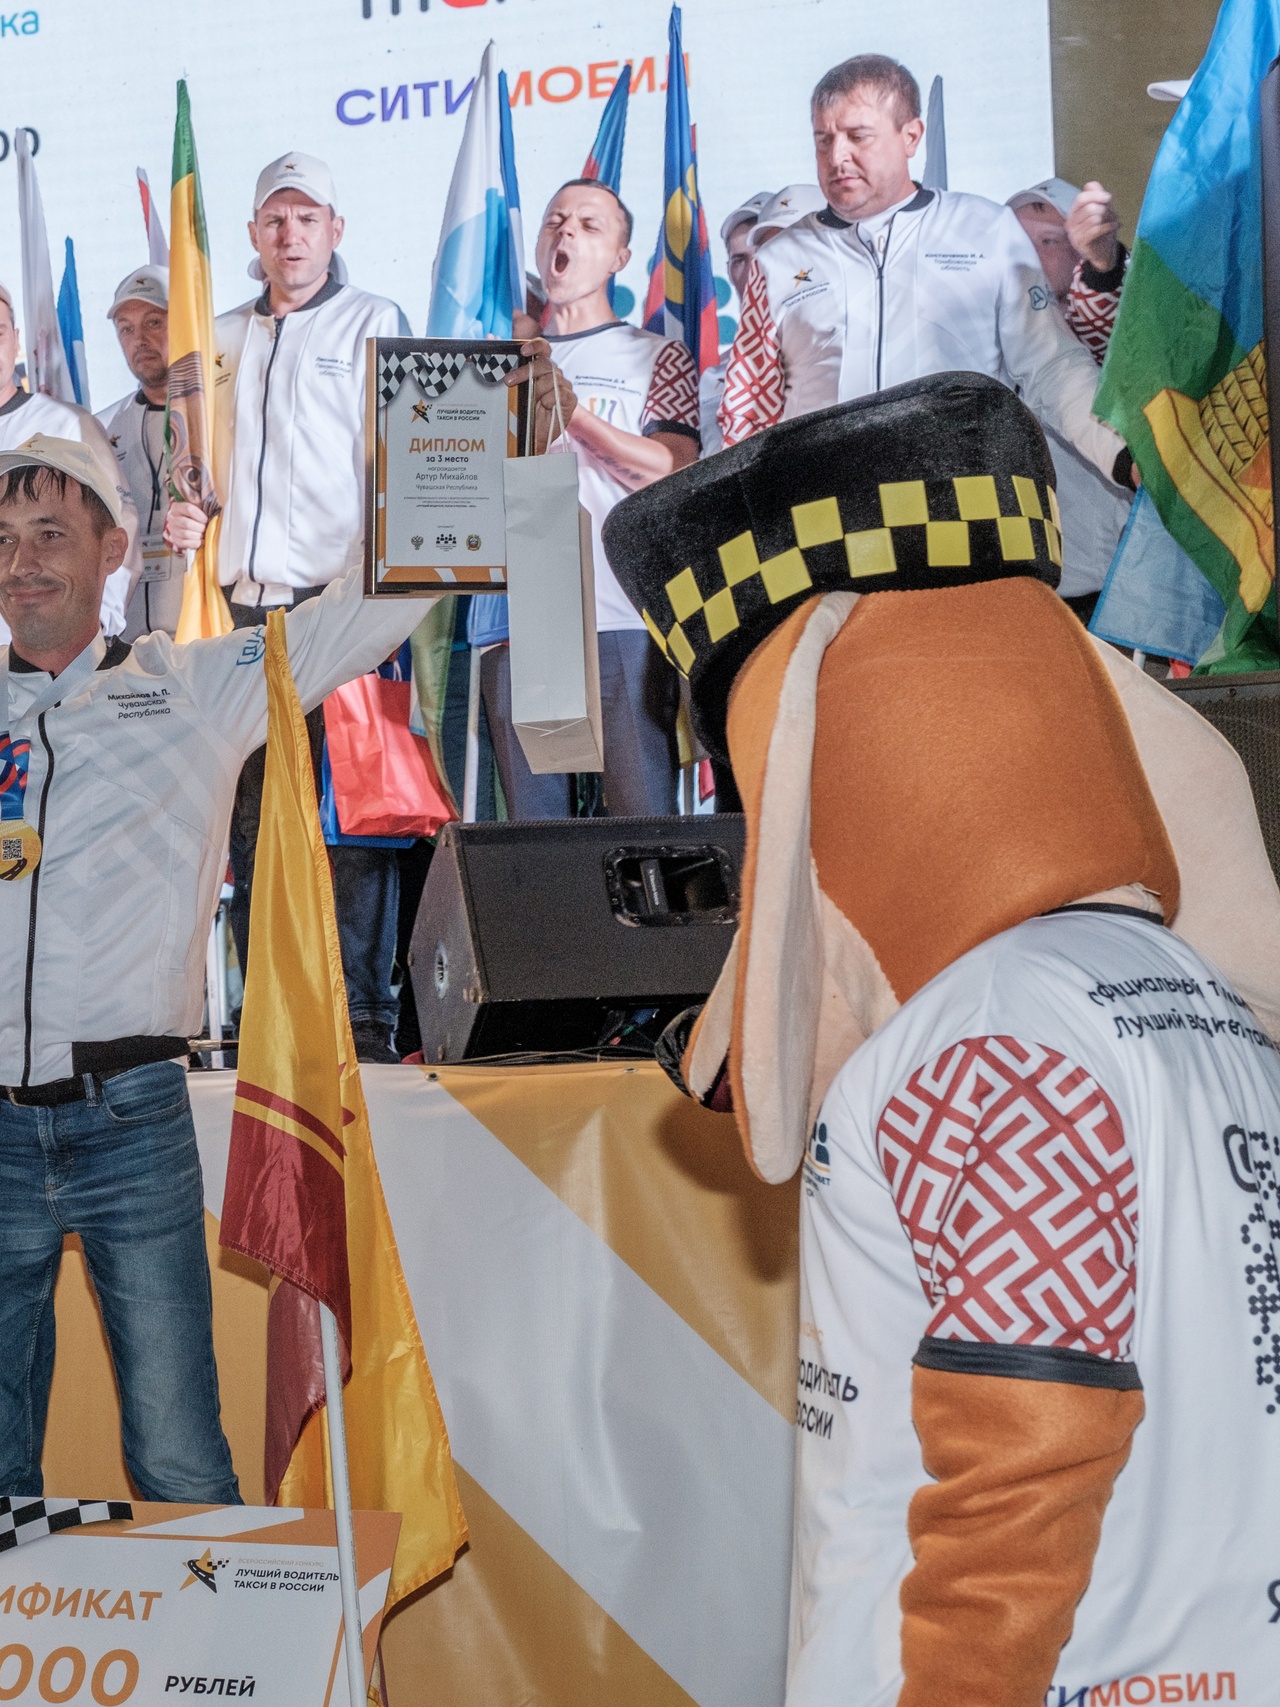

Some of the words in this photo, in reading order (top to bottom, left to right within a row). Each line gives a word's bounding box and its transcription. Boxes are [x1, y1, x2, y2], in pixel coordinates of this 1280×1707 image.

[409, 438, 486, 454] ДИПЛОМ
[437, 454, 443, 463] 3
[415, 472, 438, 482] Артур
[439, 472, 478, 481] Михайлов
[107, 692, 151, 701] Михайлов
[161, 688, 171, 696] П.
[117, 698, 167, 711] Чувашская
[117, 707, 171, 719] Республика
[235, 1568, 281, 1579] ЛУЧШИЙ
[283, 1570, 340, 1581] ВОДИТЕЛЬ
[234, 1580, 268, 1589] ТАКСИ
[270, 1581, 277, 1590] В
[278, 1582, 325, 1592] РОССИИ
[164, 1674, 257, 1697] РУБЛЕЙ
